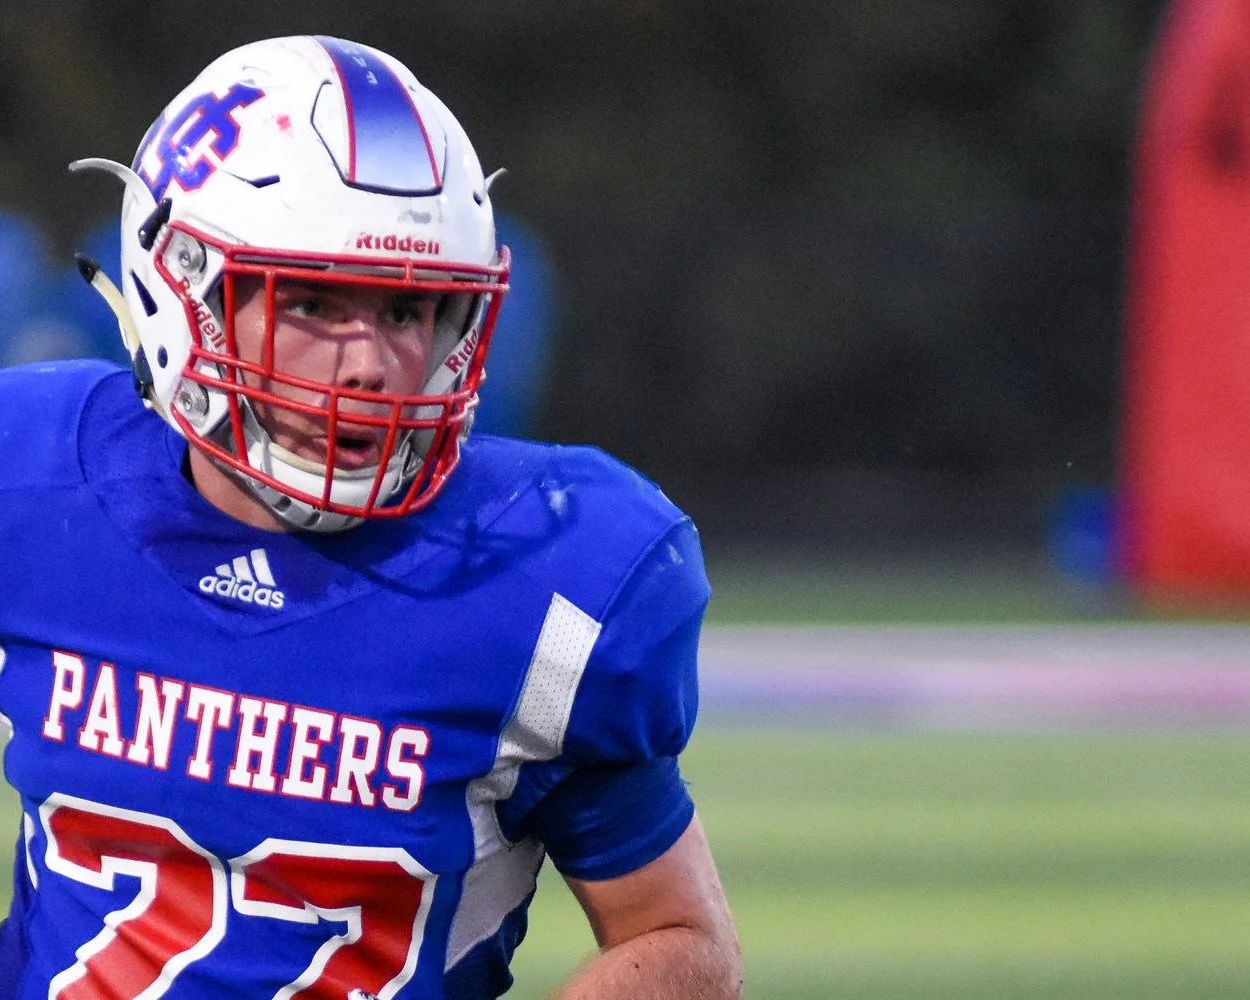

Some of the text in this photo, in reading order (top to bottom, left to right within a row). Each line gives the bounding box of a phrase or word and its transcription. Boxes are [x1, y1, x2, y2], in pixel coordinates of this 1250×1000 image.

[356, 233, 440, 255] Riddell
[180, 275, 226, 349] Rddell
[199, 575, 285, 609] adidas
[42, 650, 431, 813] PANTHERS
